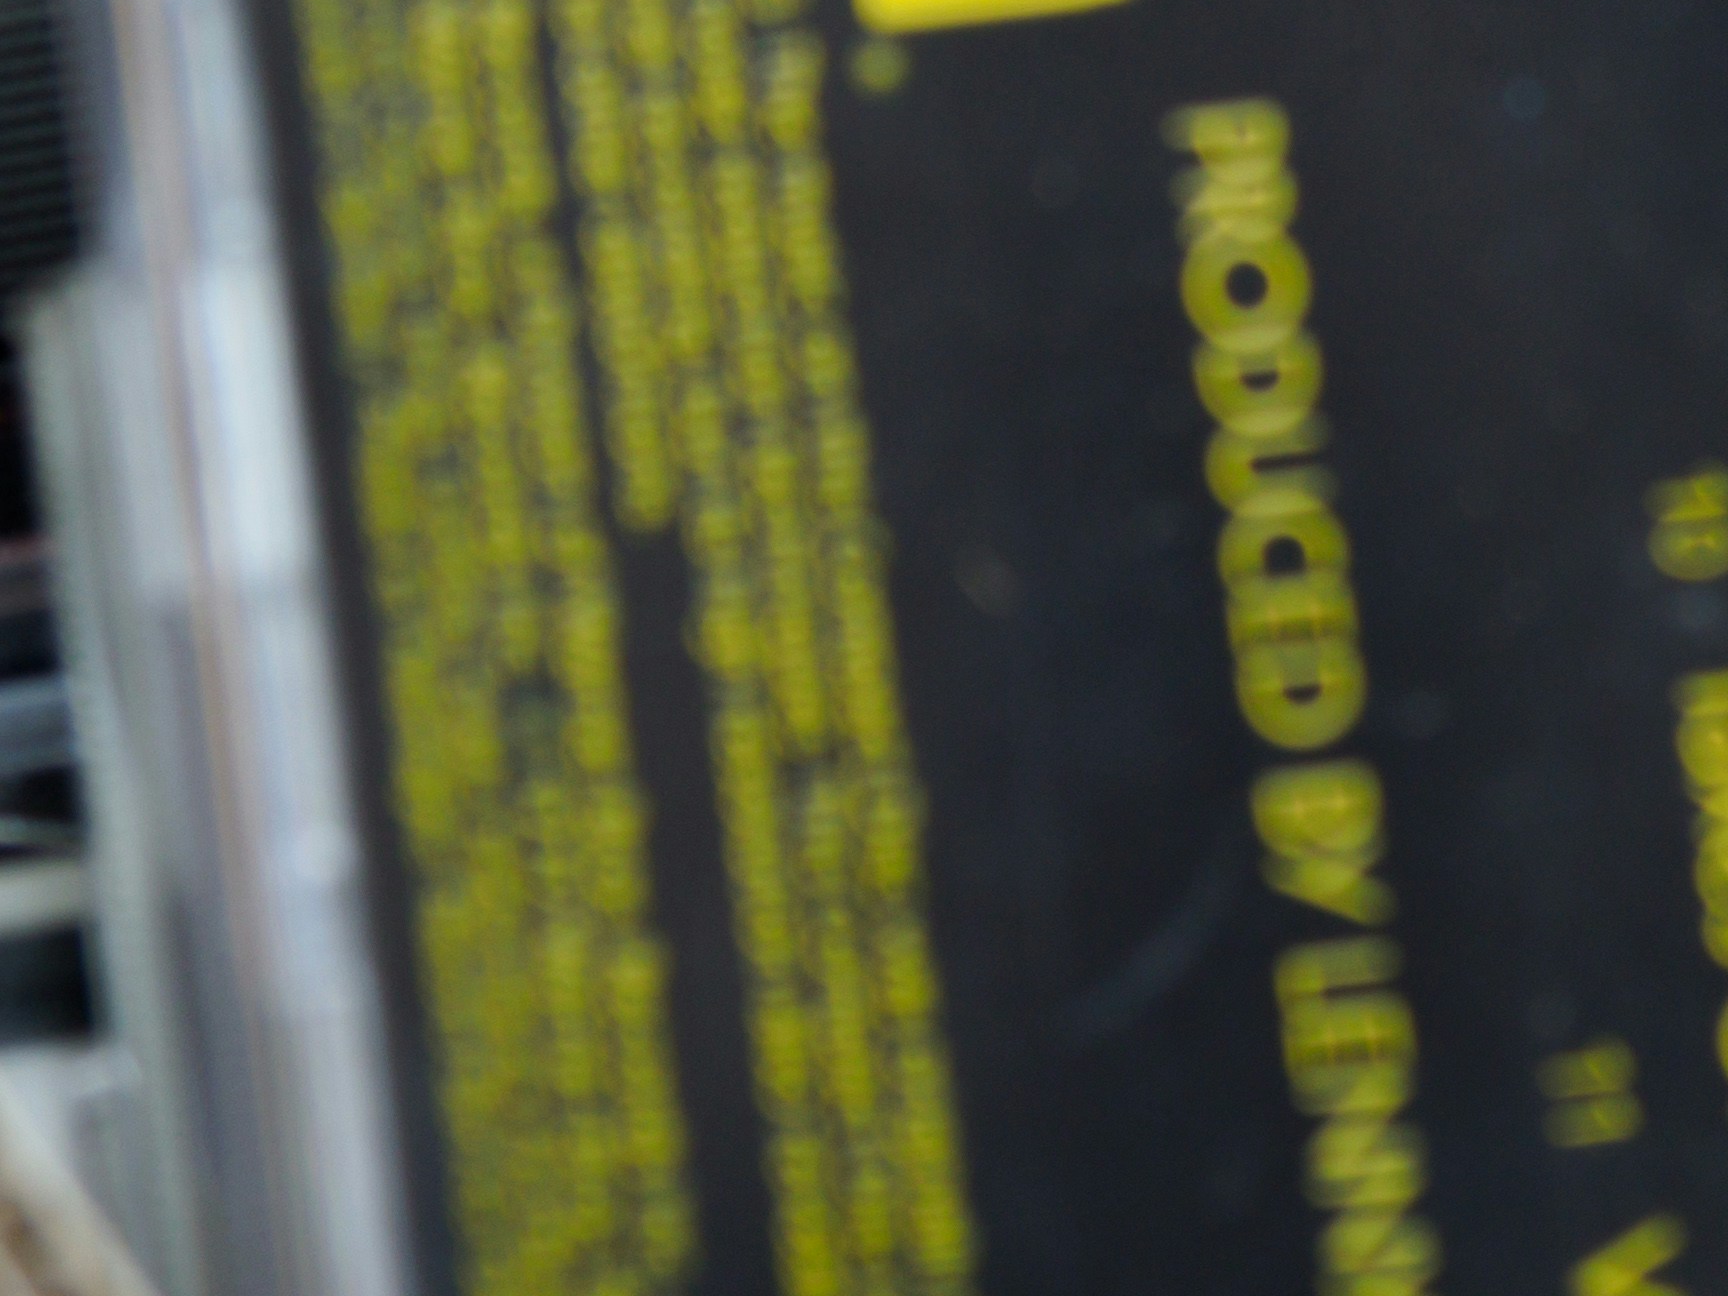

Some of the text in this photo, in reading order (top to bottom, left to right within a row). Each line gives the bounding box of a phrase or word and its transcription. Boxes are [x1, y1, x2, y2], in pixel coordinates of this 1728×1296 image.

[1160, 98, 1364, 748] PRODUCED
[1252, 758, 1396, 924] BY
[1537, 1034, 1644, 1149] 11
